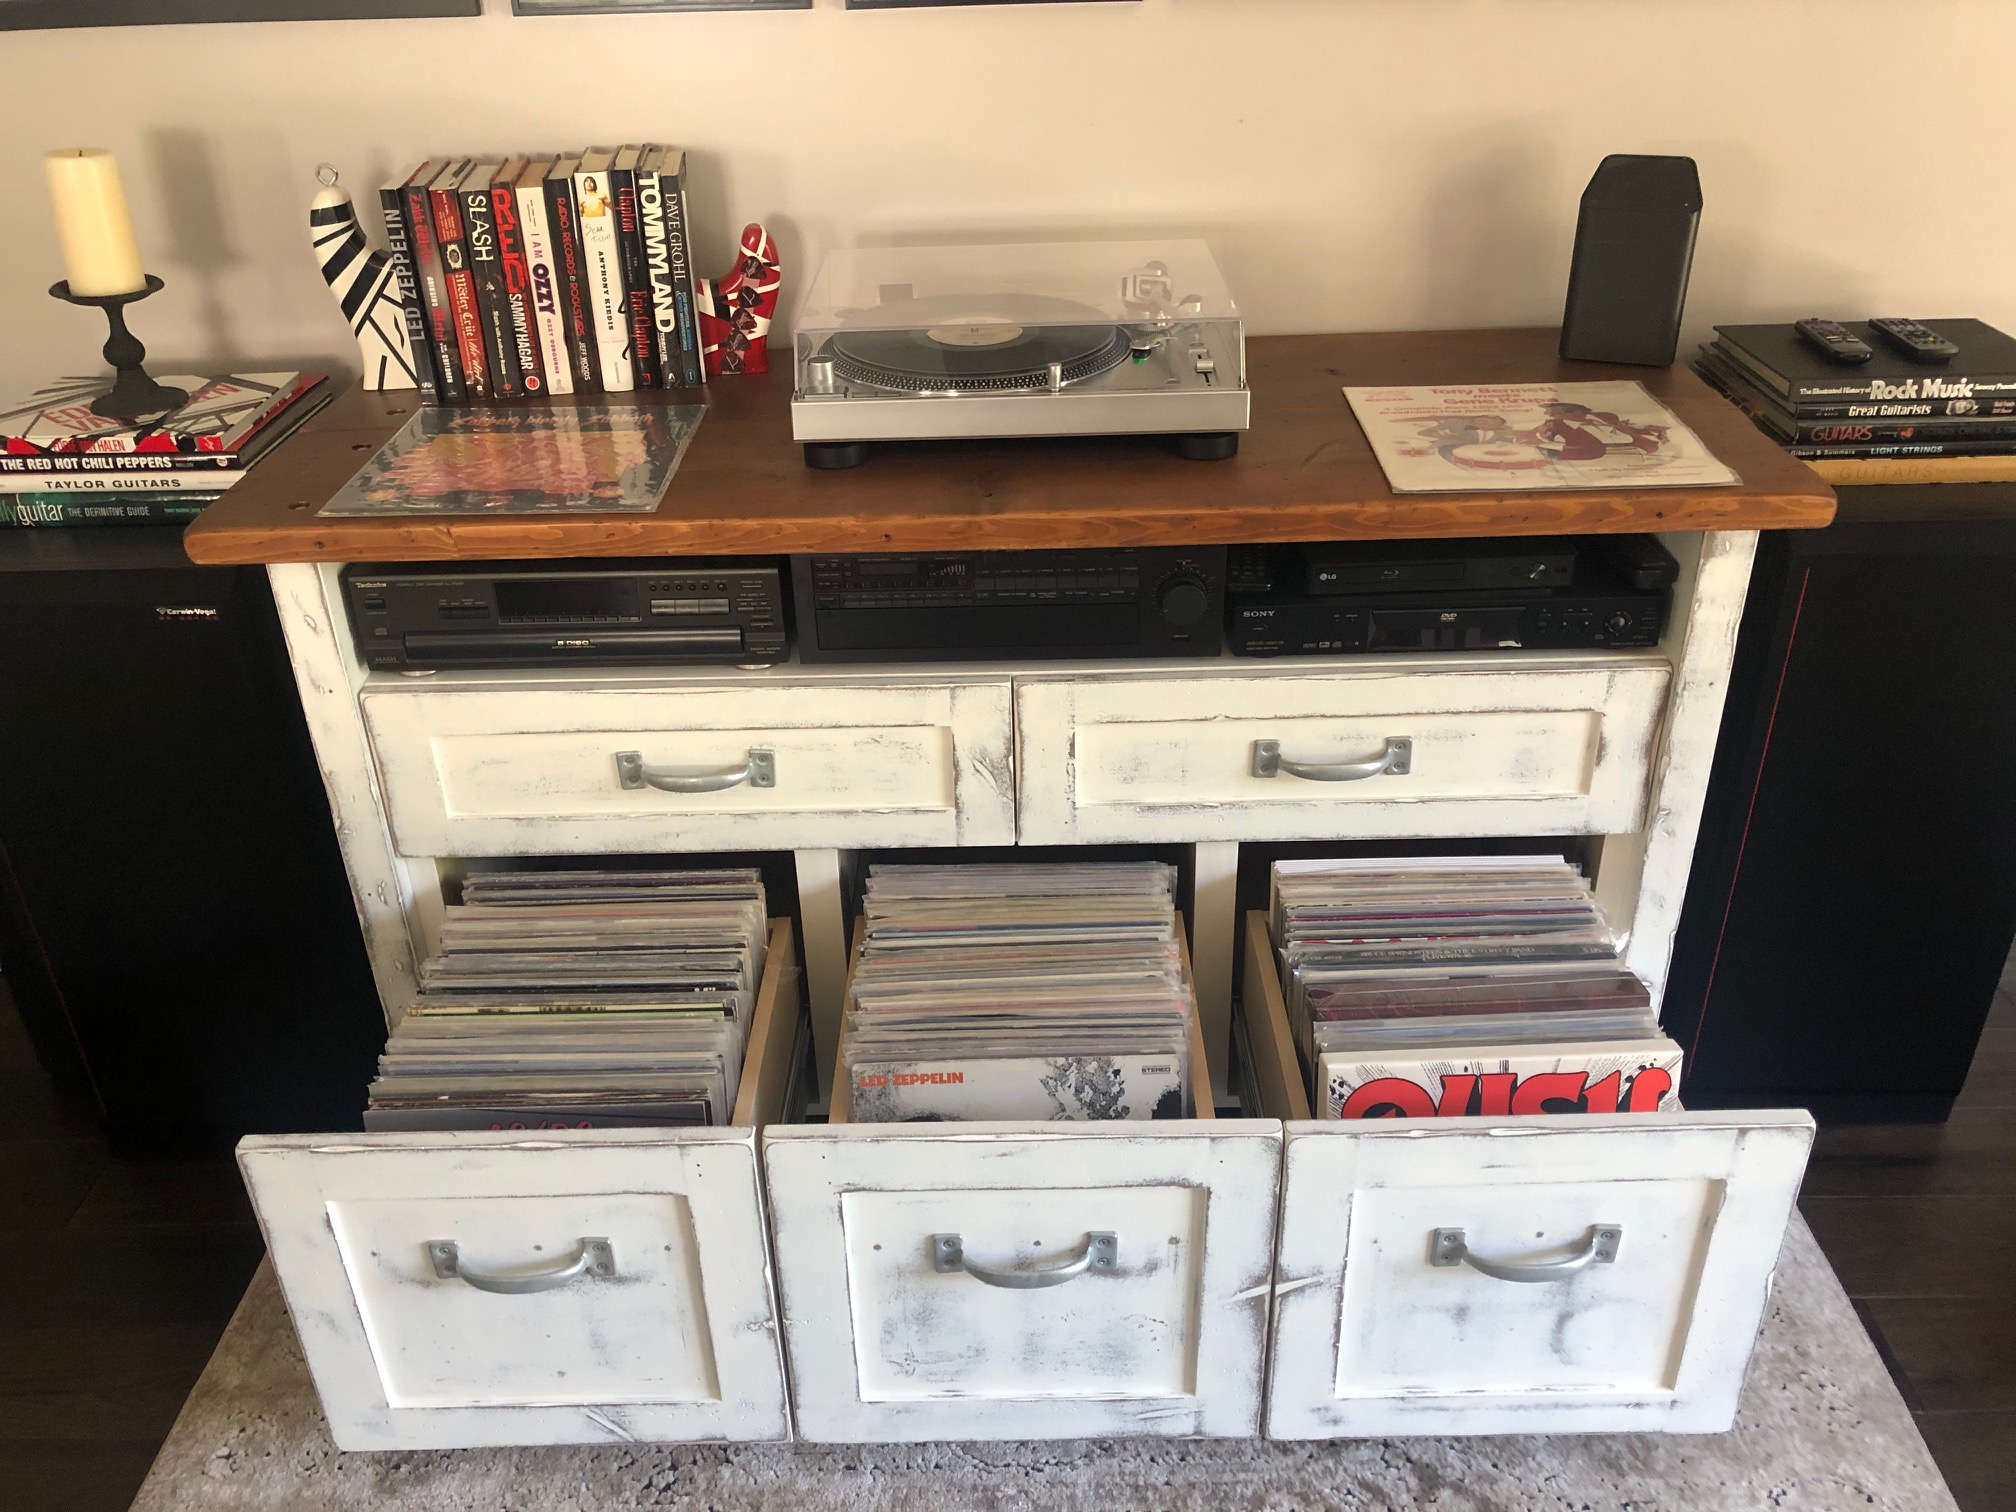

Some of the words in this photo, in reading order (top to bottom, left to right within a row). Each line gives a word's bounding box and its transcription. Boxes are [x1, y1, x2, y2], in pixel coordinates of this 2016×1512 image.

[665, 193, 681, 229] DAVE
[468, 195, 494, 261] SLASH
[384, 209, 417, 299] ZEPPELIN
[532, 241, 543, 258] AM
[562, 232, 577, 275] RECORDS
[639, 172, 675, 332] TOMMYLAND
[669, 232, 686, 283] GROHL
[532, 263, 556, 316] OZZY
[598, 251, 610, 295] ANTHONY
[605, 298, 614, 331] KIEDIS
[630, 290, 648, 313] Eric
[509, 294, 527, 333] SAMMY
[569, 283, 585, 337] ROCKSTARS
[405, 307, 425, 340] LED
[579, 341, 587, 357] JEFF
[631, 316, 651, 358] Clapton
[516, 334, 533, 370] HAGAR
[582, 357, 590, 381] WOODS
[1432, 388, 1474, 396] Tony
[1478, 386, 1558, 395] Bennett
[1843, 386, 1864, 395] History
[1869, 379, 1918, 400] Rock
[1921, 377, 1975, 399] Music
[1848, 405, 1878, 417] Great
[1880, 404, 1932, 416] Guitarists
[1811, 425, 1873, 441] GUITARS
[98, 439, 126, 452] HALEN
[1870, 447, 1899, 455] LIGHT
[1902, 445, 1943, 454] STRINGS
[1, 458, 25, 470] THE
[27, 458, 51, 470] RED
[55, 457, 79, 470] HOT
[82, 457, 114, 470] CHILI
[116, 456, 172, 469] PEPPERS
[45, 480, 105, 489] TAYLOR
[112, 478, 181, 488] GUITARS
[16, 493, 63, 527] guitar
[67, 507, 82, 517] THE
[84, 506, 125, 517] DEFINITIVE
[127, 506, 150, 517] GUIDE
[1243, 610, 1275, 618] SONY
[859, 1075, 888, 1088] LED
[892, 1071, 964, 1086] ZEPPELIN
